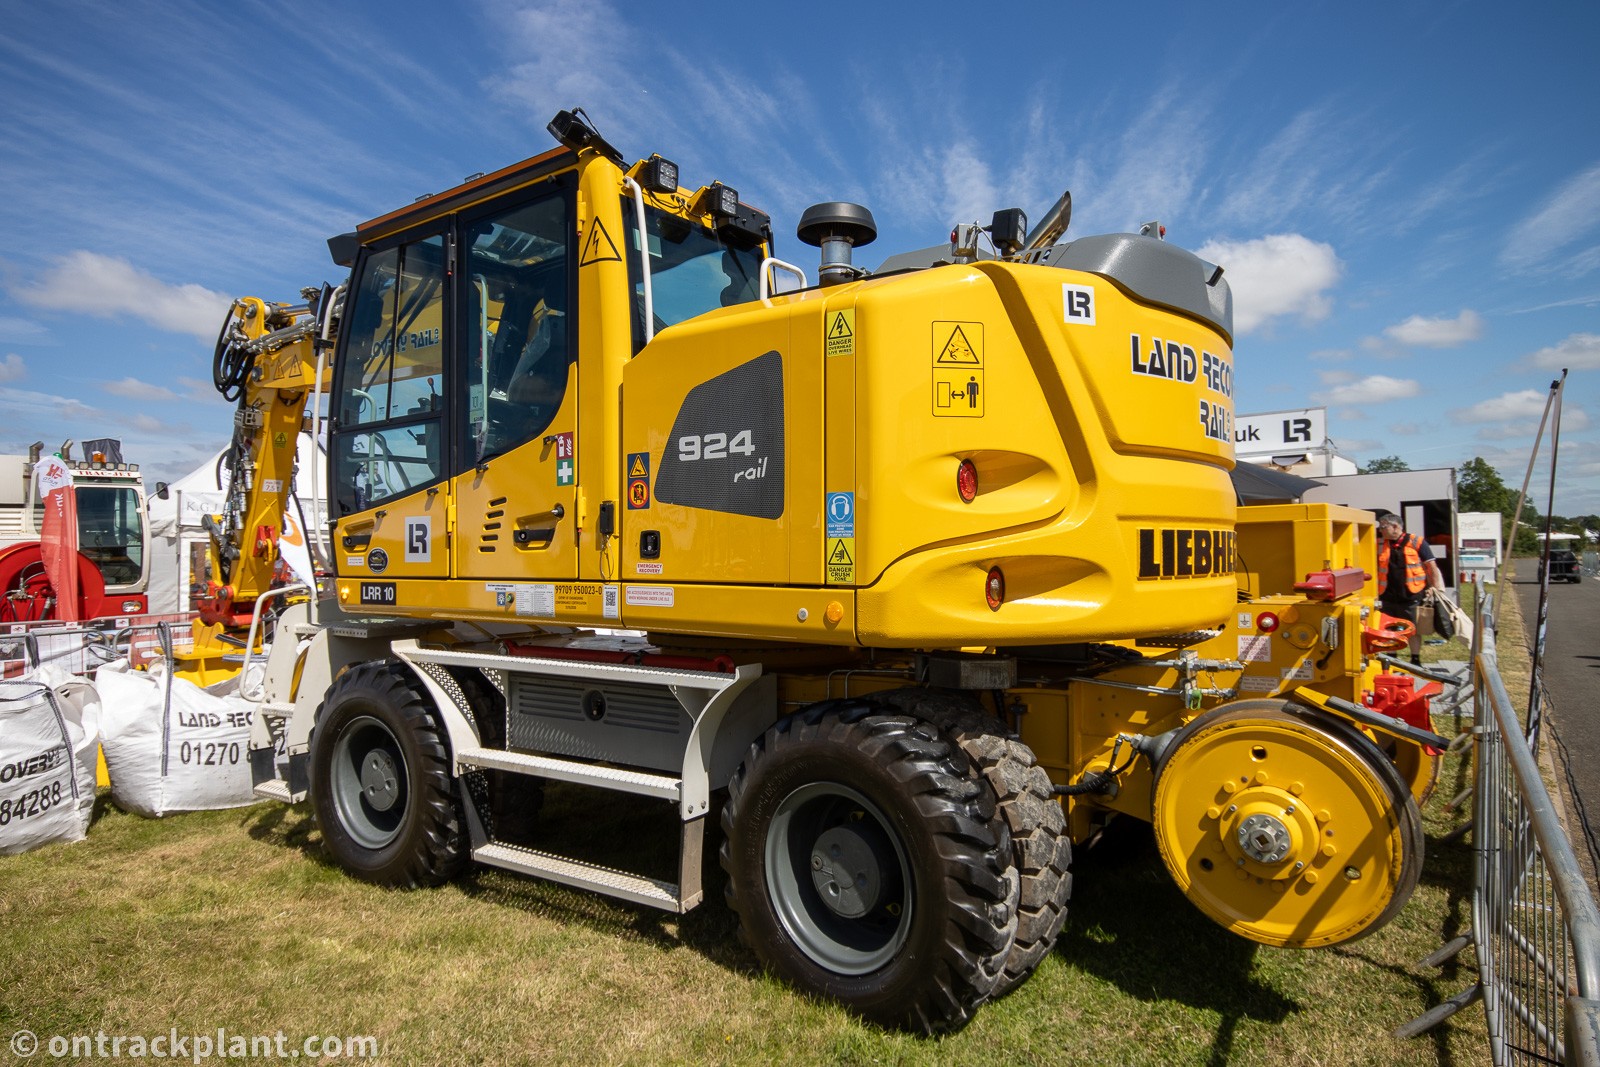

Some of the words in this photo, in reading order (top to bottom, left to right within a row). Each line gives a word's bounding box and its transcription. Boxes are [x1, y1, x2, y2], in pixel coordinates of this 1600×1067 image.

[1130, 334, 1197, 383] LAND
[1202, 351, 1233, 400] RECO
[1200, 400, 1227, 441] RAIL
[678, 429, 756, 461] 924
[733, 456, 768, 483] rail
[1139, 528, 1237, 577] LIEBHE
[362, 586, 381, 600] LRR
[384, 586, 394, 601] 10
[178, 711, 221, 728] LAND
[226, 711, 254, 728] REC
[180, 741, 240, 765] 01270
[0, 780, 61, 826] 84288
